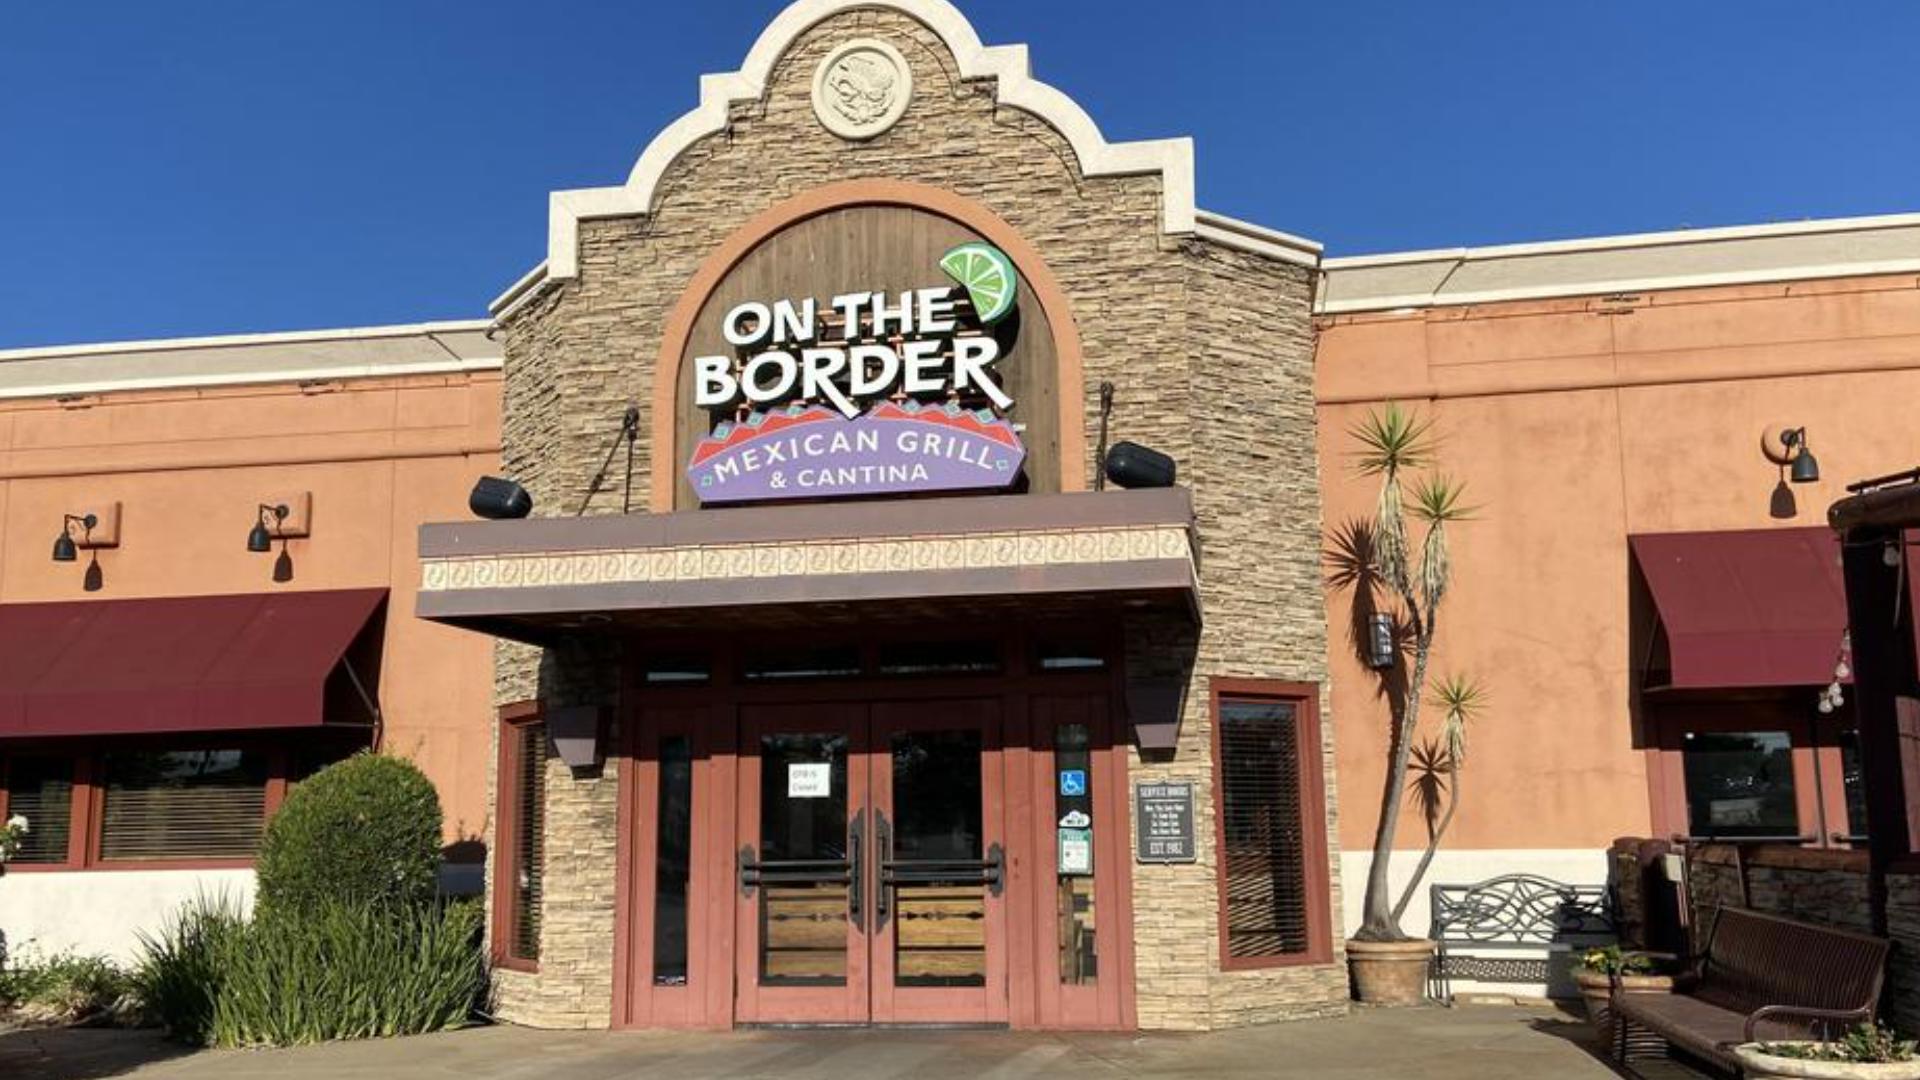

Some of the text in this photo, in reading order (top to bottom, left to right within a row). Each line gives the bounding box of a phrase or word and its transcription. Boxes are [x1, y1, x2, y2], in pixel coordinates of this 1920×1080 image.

[724, 287, 957, 345] ON THE
[695, 336, 1015, 420] BORDER
[713, 430, 993, 483] MEXICAN GRILL
[769, 463, 929, 489] & CANTINA
